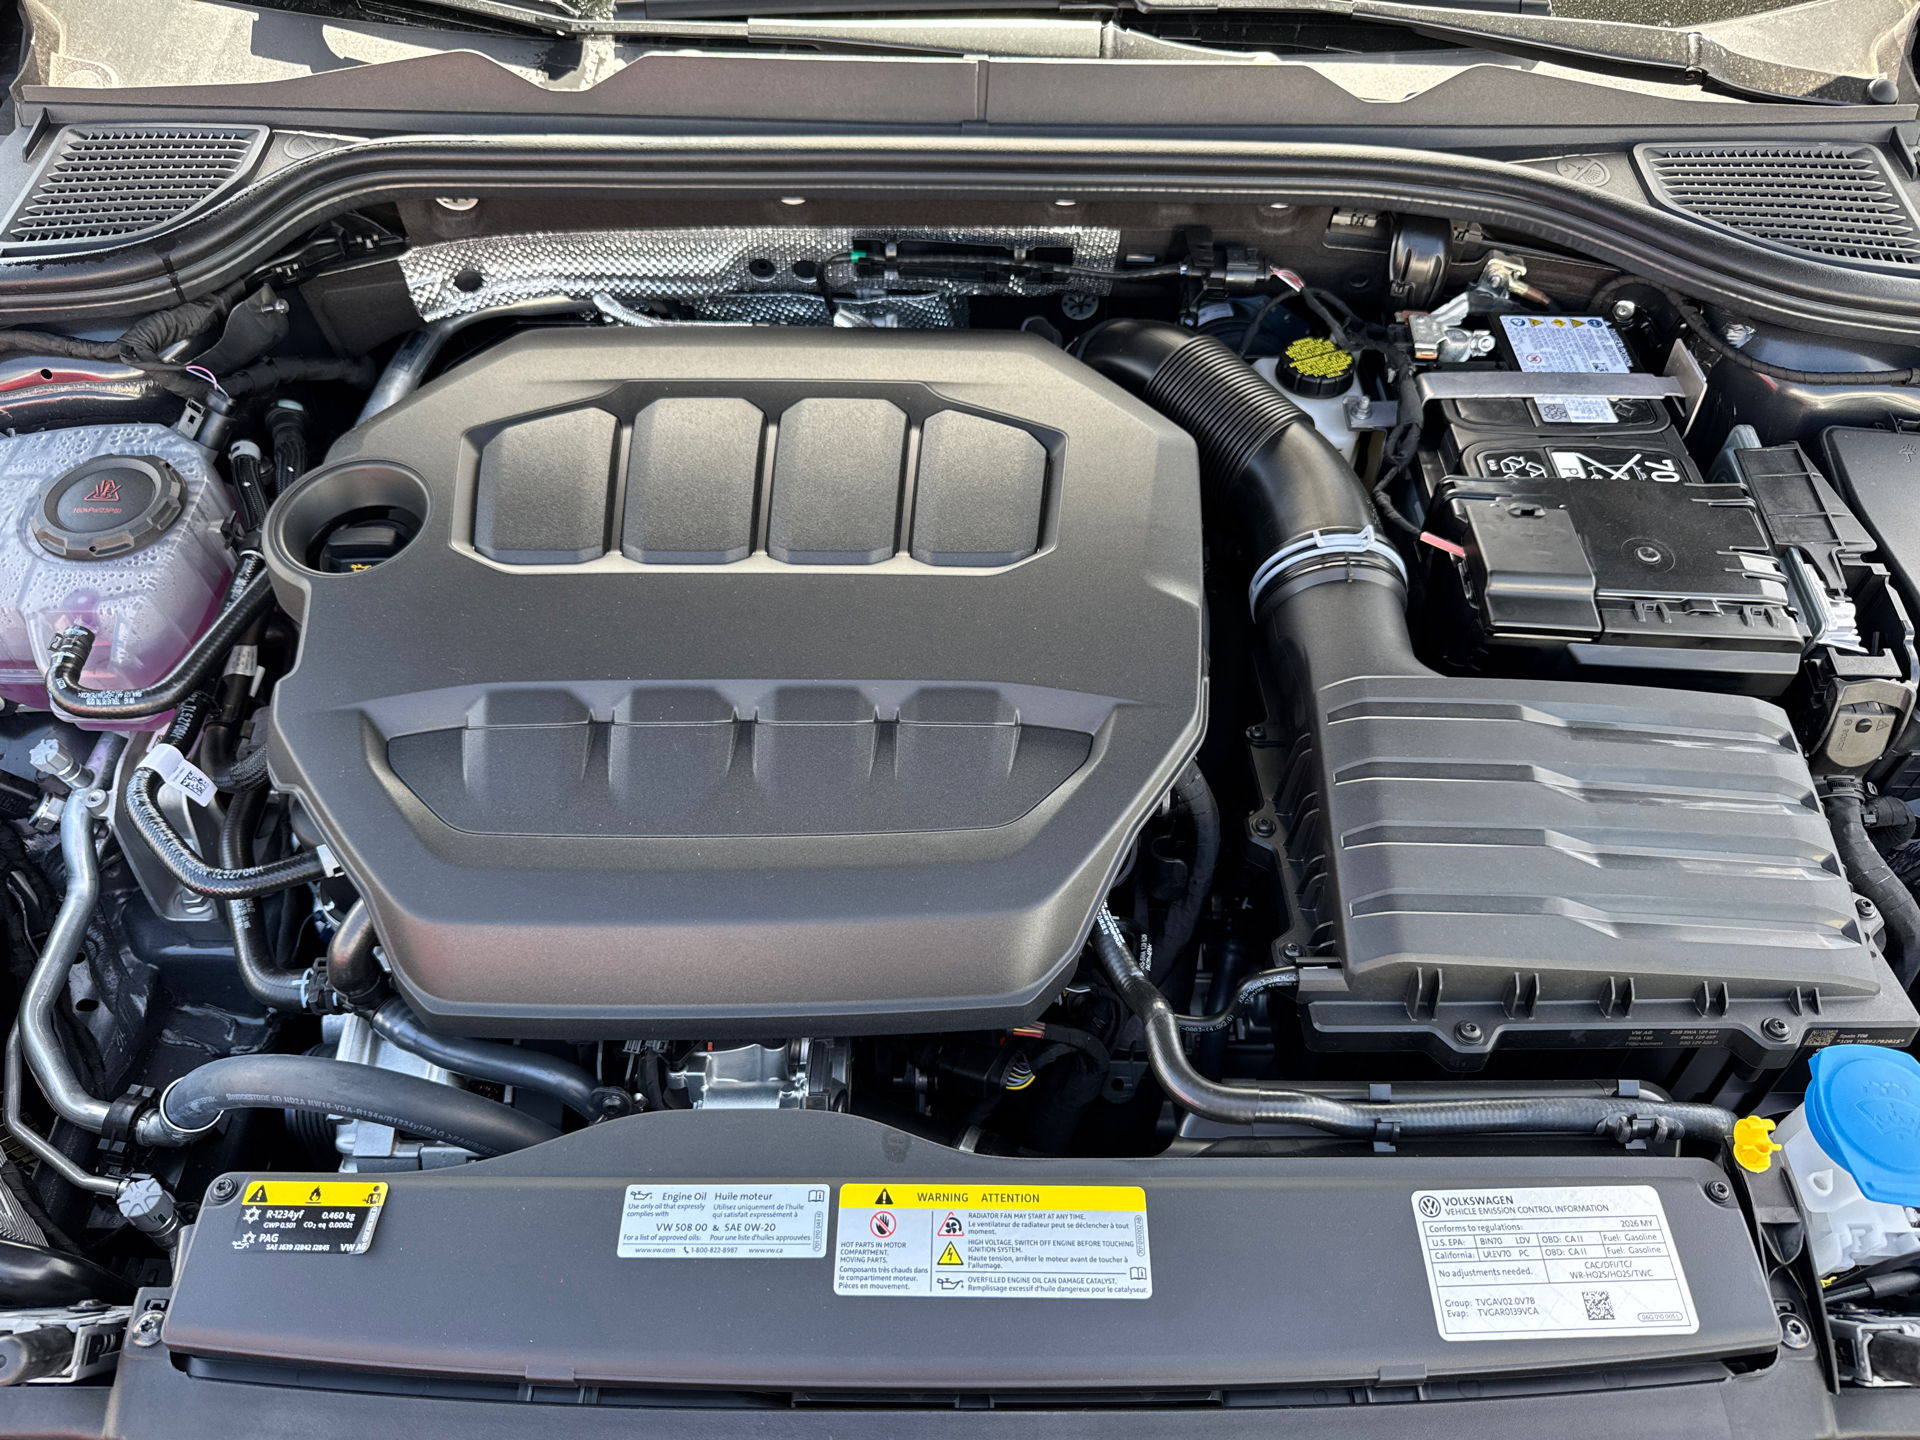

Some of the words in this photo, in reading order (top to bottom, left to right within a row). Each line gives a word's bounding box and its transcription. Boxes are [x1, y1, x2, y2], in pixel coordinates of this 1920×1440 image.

[1644, 459, 1681, 483] 70
[662, 1192, 692, 1203] Engine
[694, 1192, 707, 1201] Oil
[714, 1192, 738, 1200] Huile
[917, 1192, 969, 1202] WARNING
[981, 1193, 1040, 1203] ATTENTION
[1442, 1196, 1514, 1206] VOLKSWAGEN
[640, 1203, 654, 1211] only
[677, 1203, 706, 1211] expressly
[1445, 1208, 1477, 1216] VEHICLE
[1479, 1207, 1516, 1215] EMISSION
[1518, 1206, 1554, 1214] CONTROL
[1556, 1204, 1609, 1213] INFORMATION
[266, 1210, 304, 1221] R-1234yf
[345, 1212, 356, 1221] kg
[749, 1211, 793, 1219] expressément
[656, 1223, 673, 1232] VW
[675, 1223, 693, 1232] 508
[694, 1223, 708, 1232] 00
[712, 1224, 719, 1232] &
[724, 1223, 742, 1232] SAE
[744, 1223, 776, 1232] 0W-20
[1429, 1224, 1466, 1233] Conforms
[1478, 1224, 1523, 1233] regulations:
[1620, 1220, 1640, 1228] 2026
[259, 1234, 279, 1242] PAG
[658, 1234, 687, 1242] approved
[776, 1234, 812, 1242] approuvées:
[1432, 1239, 1447, 1247] U.S.
[1449, 1238, 1466, 1246] EPA:
[1515, 1236, 1530, 1244] LDV
[1565, 1235, 1576, 1243] CA
[1604, 1234, 1621, 1242] Fuel:
[1624, 1233, 1657, 1241] Gasoline
[355, 1243, 366, 1251] AG
[1435, 1251, 1475, 1259] California:
[1483, 1250, 1512, 1258] ULEV70
[1519, 1249, 1530, 1257] PC
[1568, 1248, 1580, 1256] CA
[1606, 1246, 1625, 1255] Fuel:
[1628, 1246, 1662, 1254] Gasoline
[1584, 1260, 1632, 1269] CAC/DFI/TC/
[839, 1266, 877, 1274] Composants
[1452, 1268, 1501, 1279] adjustments
[1502, 1267, 1533, 1275] needed.
[846, 1274, 892, 1282] compartiment
[968, 1285, 1008, 1293] Remplissage
[1057, 1286, 1090, 1294] dangereux
[1114, 1286, 1148, 1294] catalyseur.
[1445, 1299, 1473, 1309] Group:
[1475, 1297, 1535, 1307] TVGAV02.0V7B
[1447, 1310, 1469, 1319] Evap:
[1477, 1307, 1539, 1317] TVGAR0139VCA
